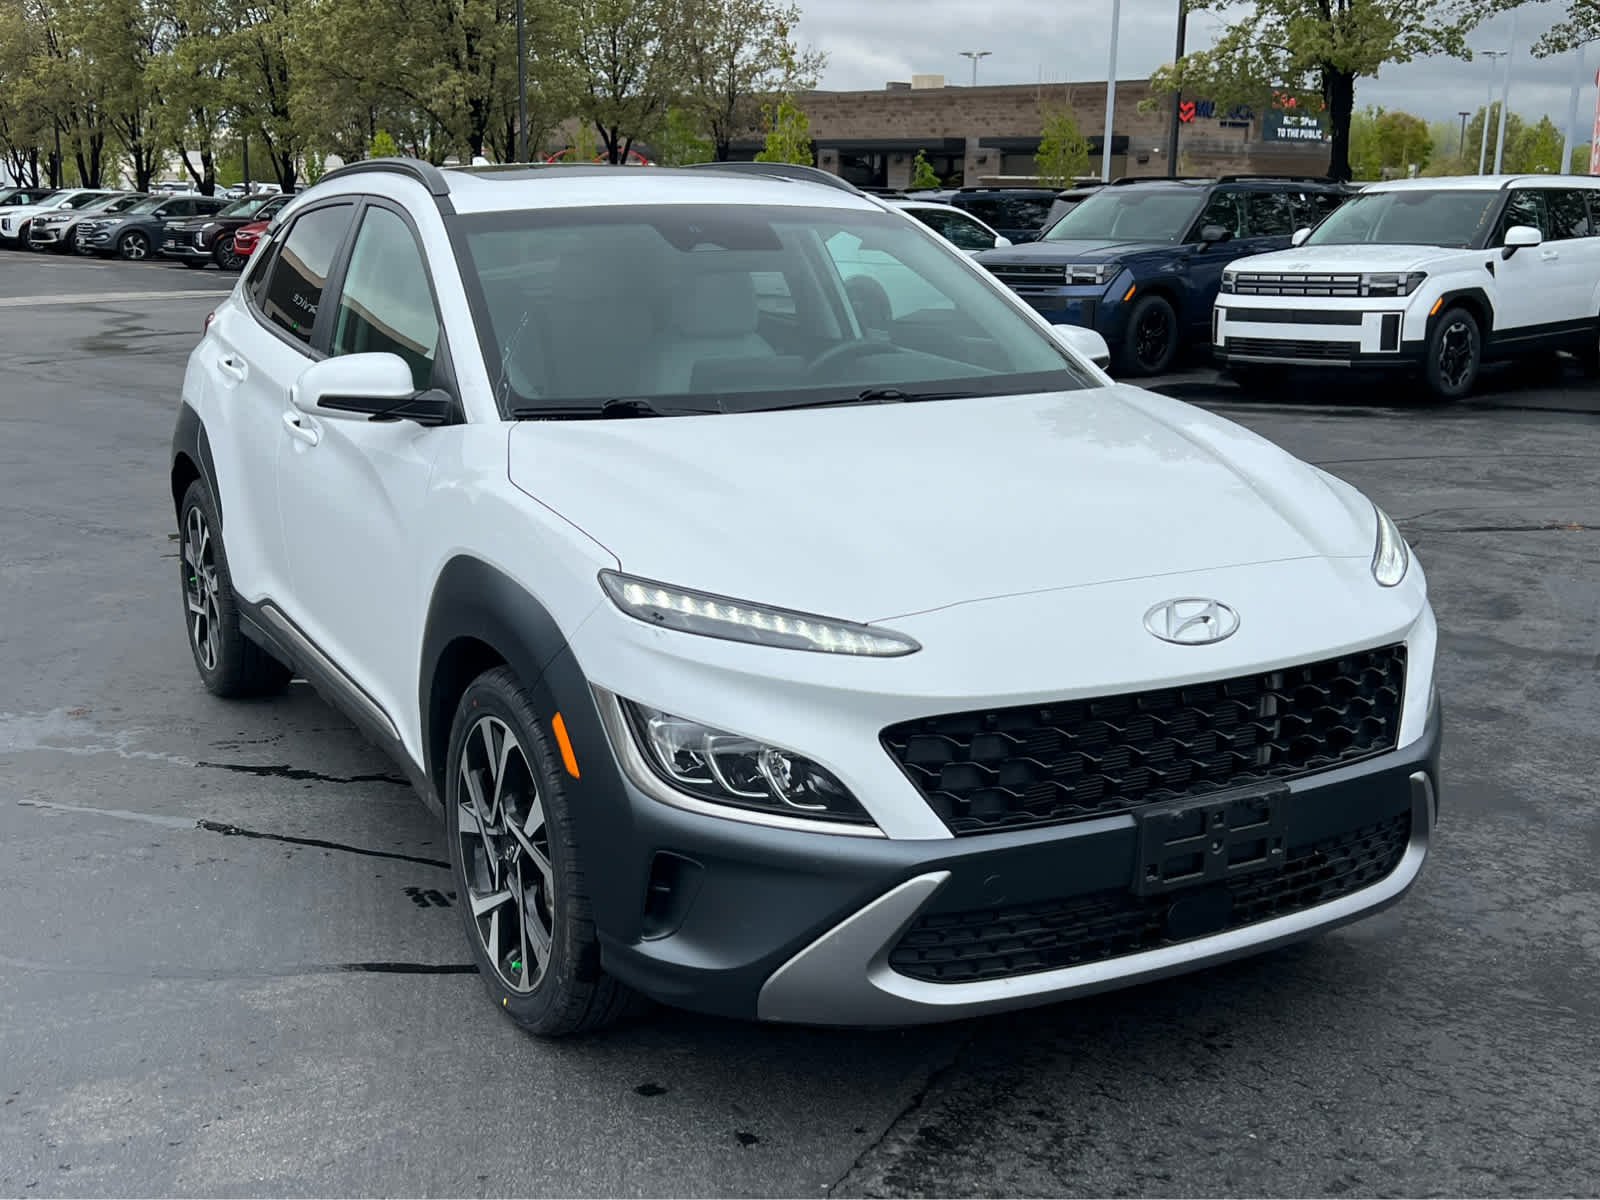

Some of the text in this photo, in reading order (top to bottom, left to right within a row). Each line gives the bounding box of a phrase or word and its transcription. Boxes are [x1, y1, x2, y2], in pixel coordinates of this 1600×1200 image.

[1277, 127, 1322, 139] TO THE PUBLIC
